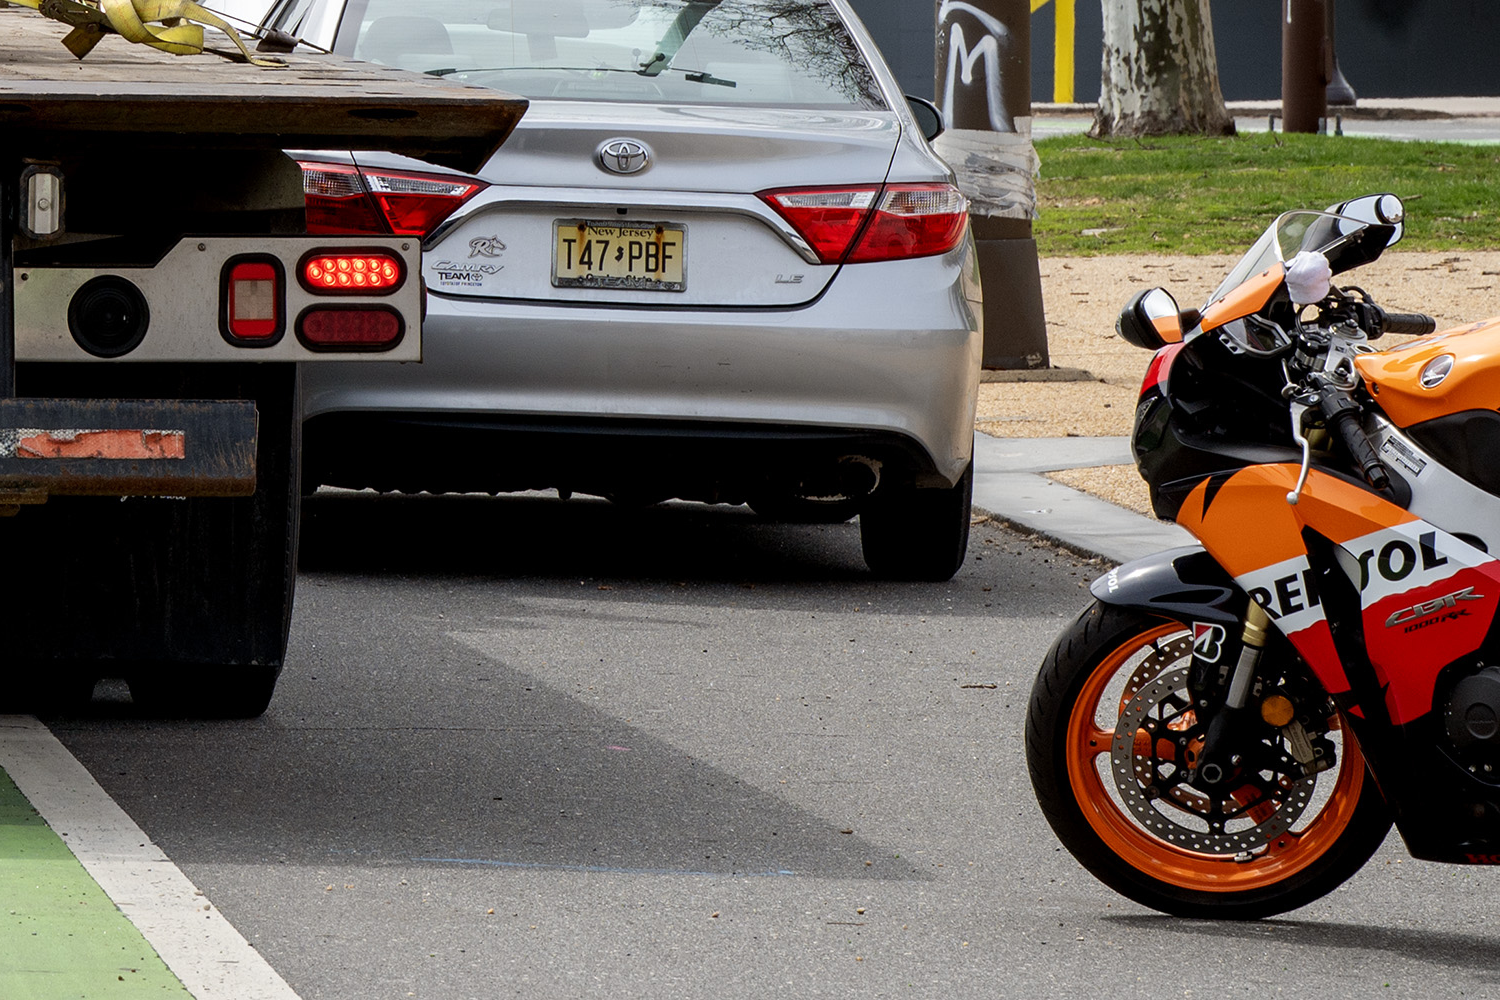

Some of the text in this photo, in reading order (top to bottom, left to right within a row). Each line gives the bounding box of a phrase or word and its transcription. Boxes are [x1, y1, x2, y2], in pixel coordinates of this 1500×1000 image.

[588, 227, 653, 238] New Jersey
[563, 238, 676, 273] T47 PBF
[431, 260, 504, 275] CAMRY
[438, 272, 470, 281] TEAM
[1385, 585, 1485, 629] CBR
